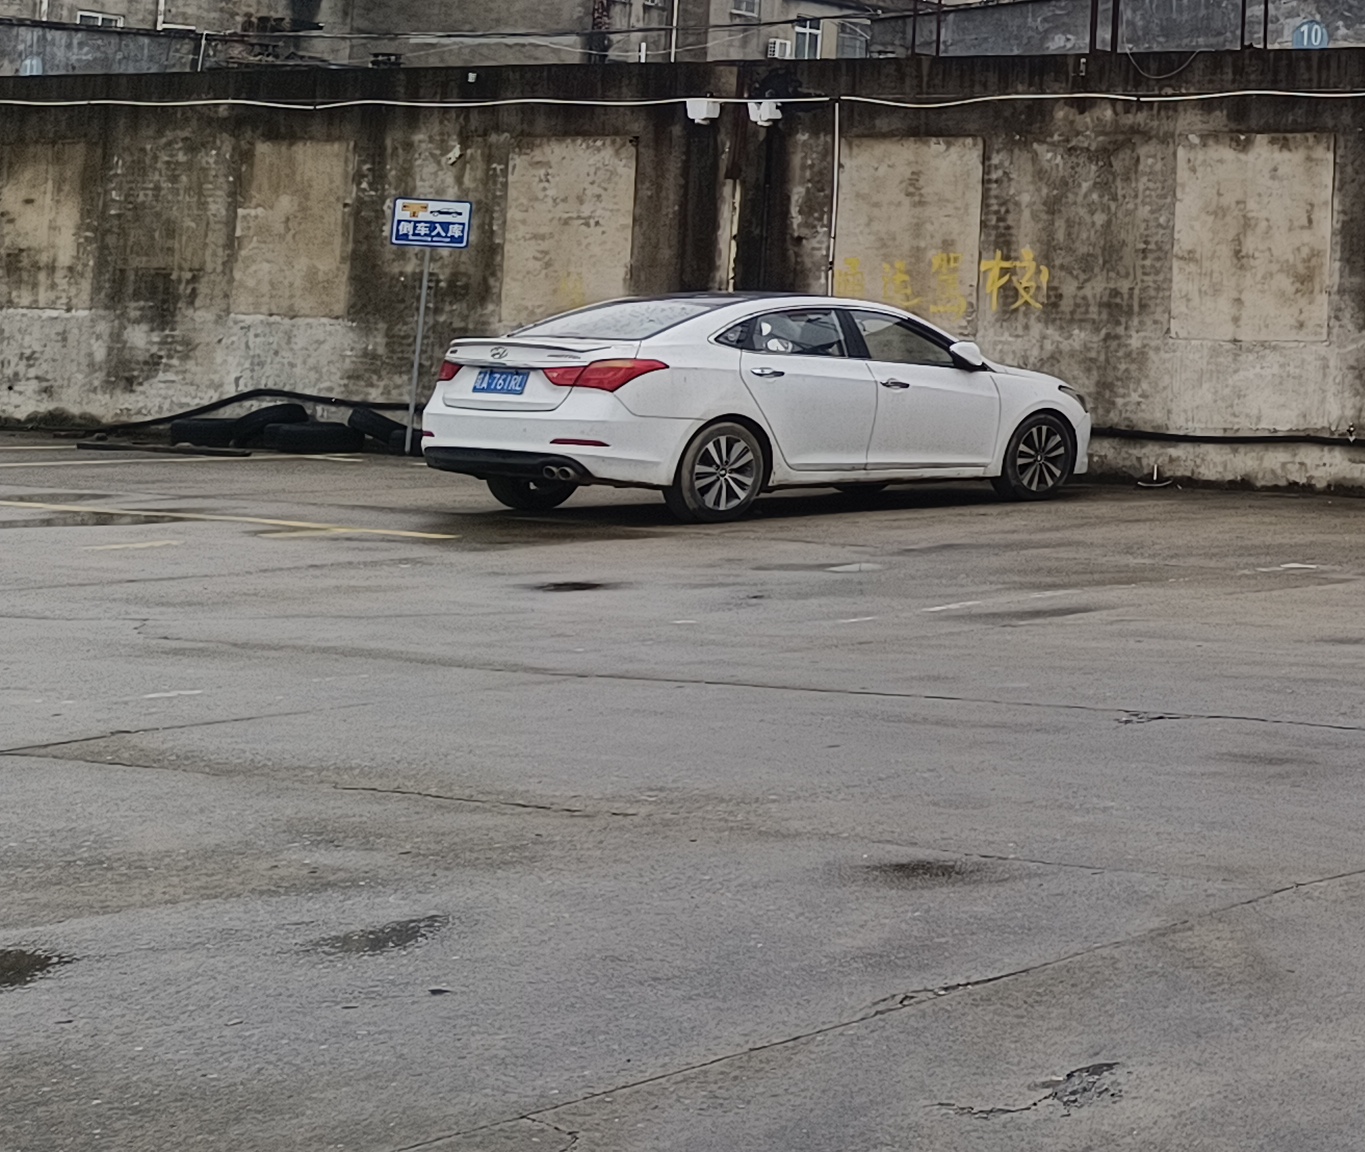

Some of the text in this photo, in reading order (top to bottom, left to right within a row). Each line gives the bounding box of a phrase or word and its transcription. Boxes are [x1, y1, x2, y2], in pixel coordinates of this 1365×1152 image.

[1300, 24, 1322, 46] 10
[398, 221, 463, 238] 倒车入库
